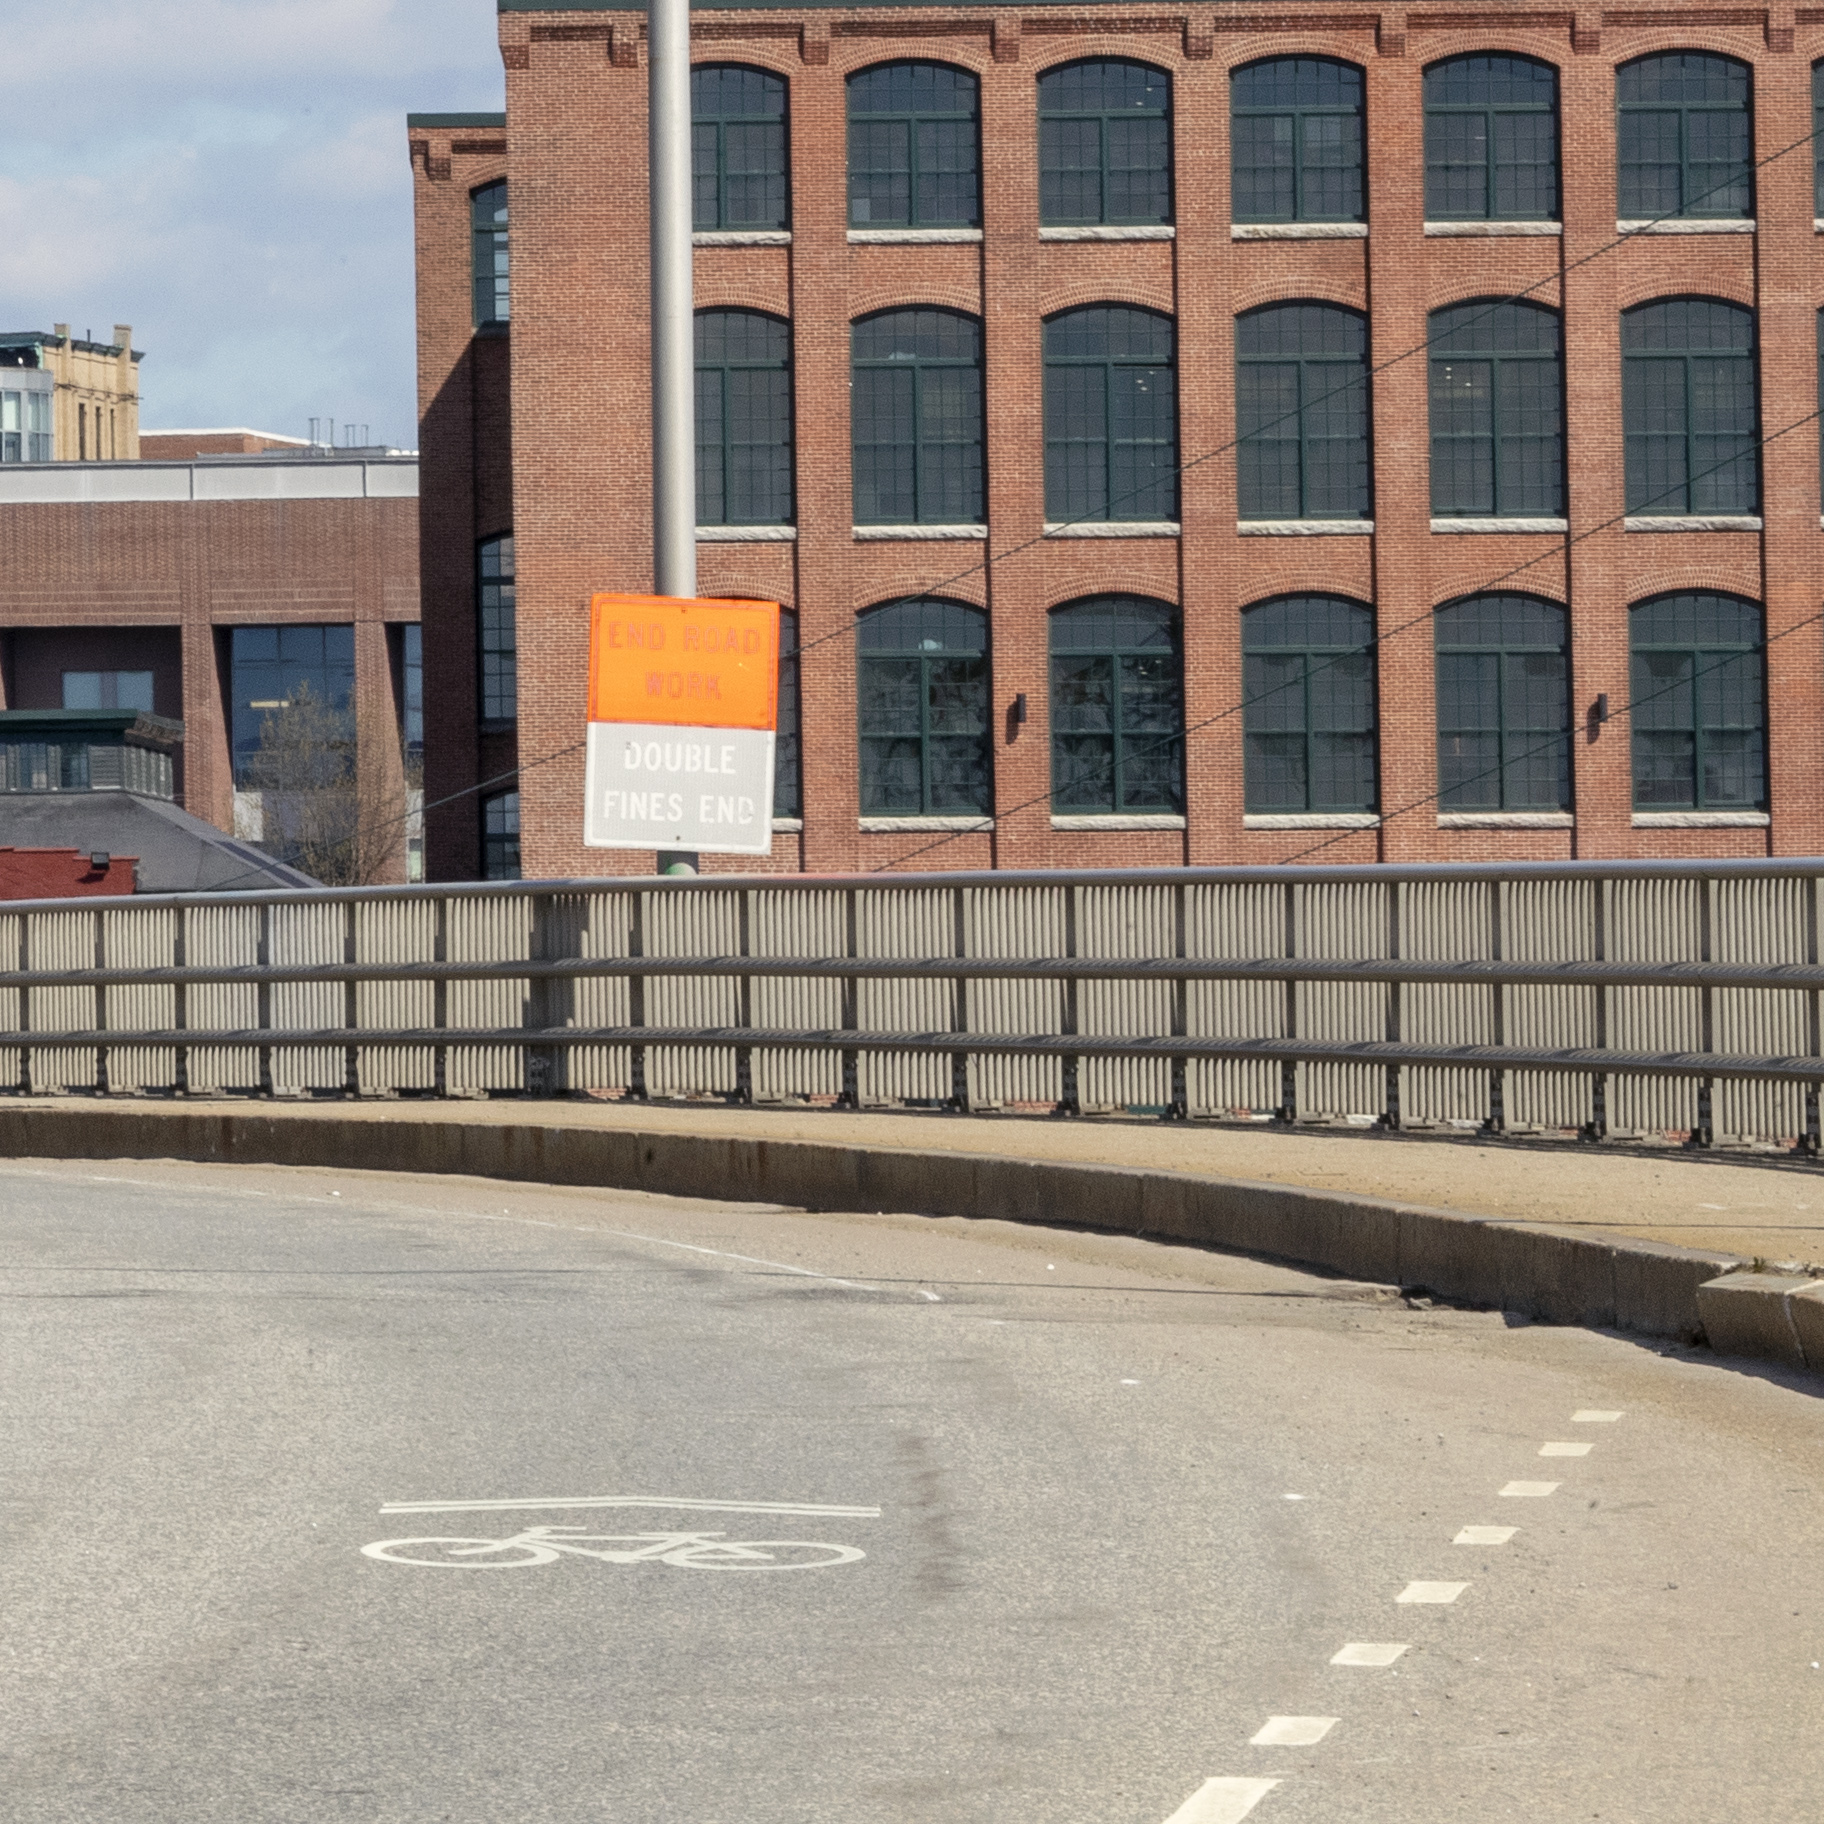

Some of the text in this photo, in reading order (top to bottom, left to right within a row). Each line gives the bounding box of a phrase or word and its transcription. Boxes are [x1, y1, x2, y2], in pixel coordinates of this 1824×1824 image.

[609, 621, 761, 655] END ROAD
[645, 671, 722, 700] WORK
[624, 742, 736, 774] DOUBLE
[604, 790, 753, 824] FINES END
